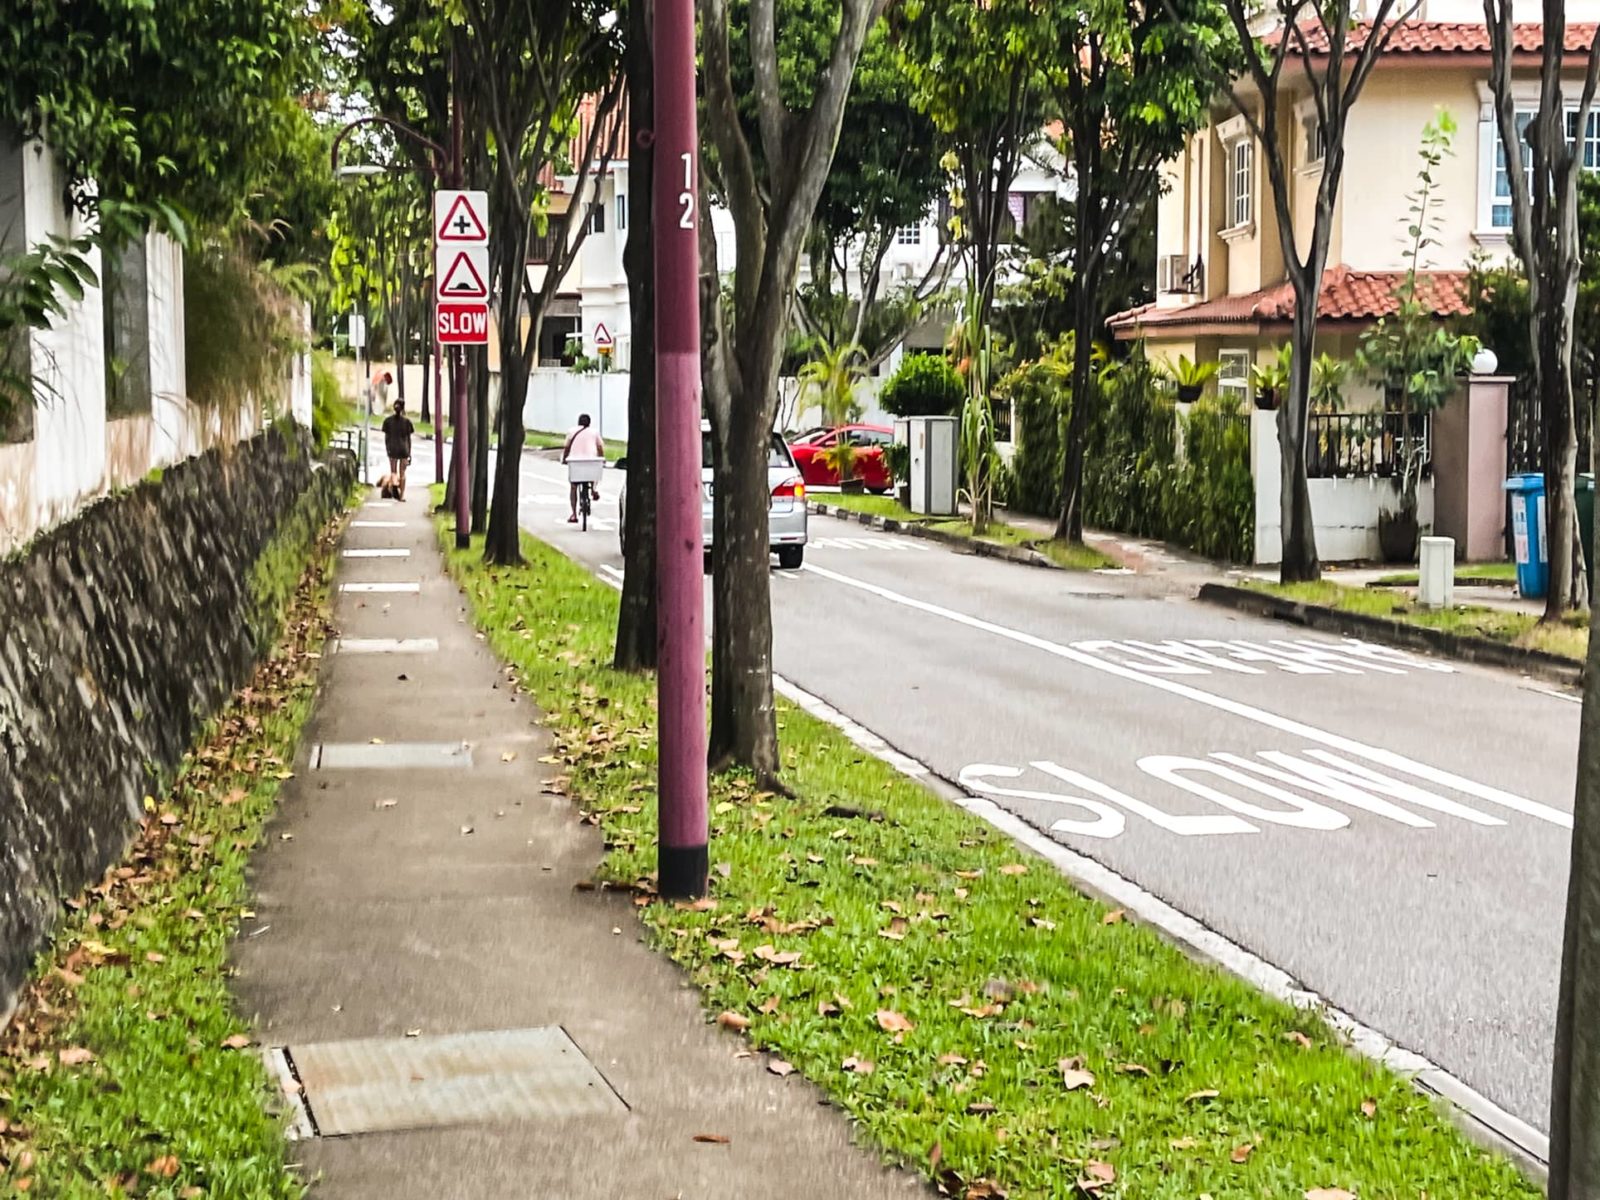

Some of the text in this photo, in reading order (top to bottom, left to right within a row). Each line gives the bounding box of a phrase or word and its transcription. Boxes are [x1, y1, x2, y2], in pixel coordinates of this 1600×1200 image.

[679, 152, 694, 229] 12
[438, 312, 487, 335] SLOW
[1068, 637, 1460, 675] AHEAD
[958, 749, 1508, 839] SLOW
